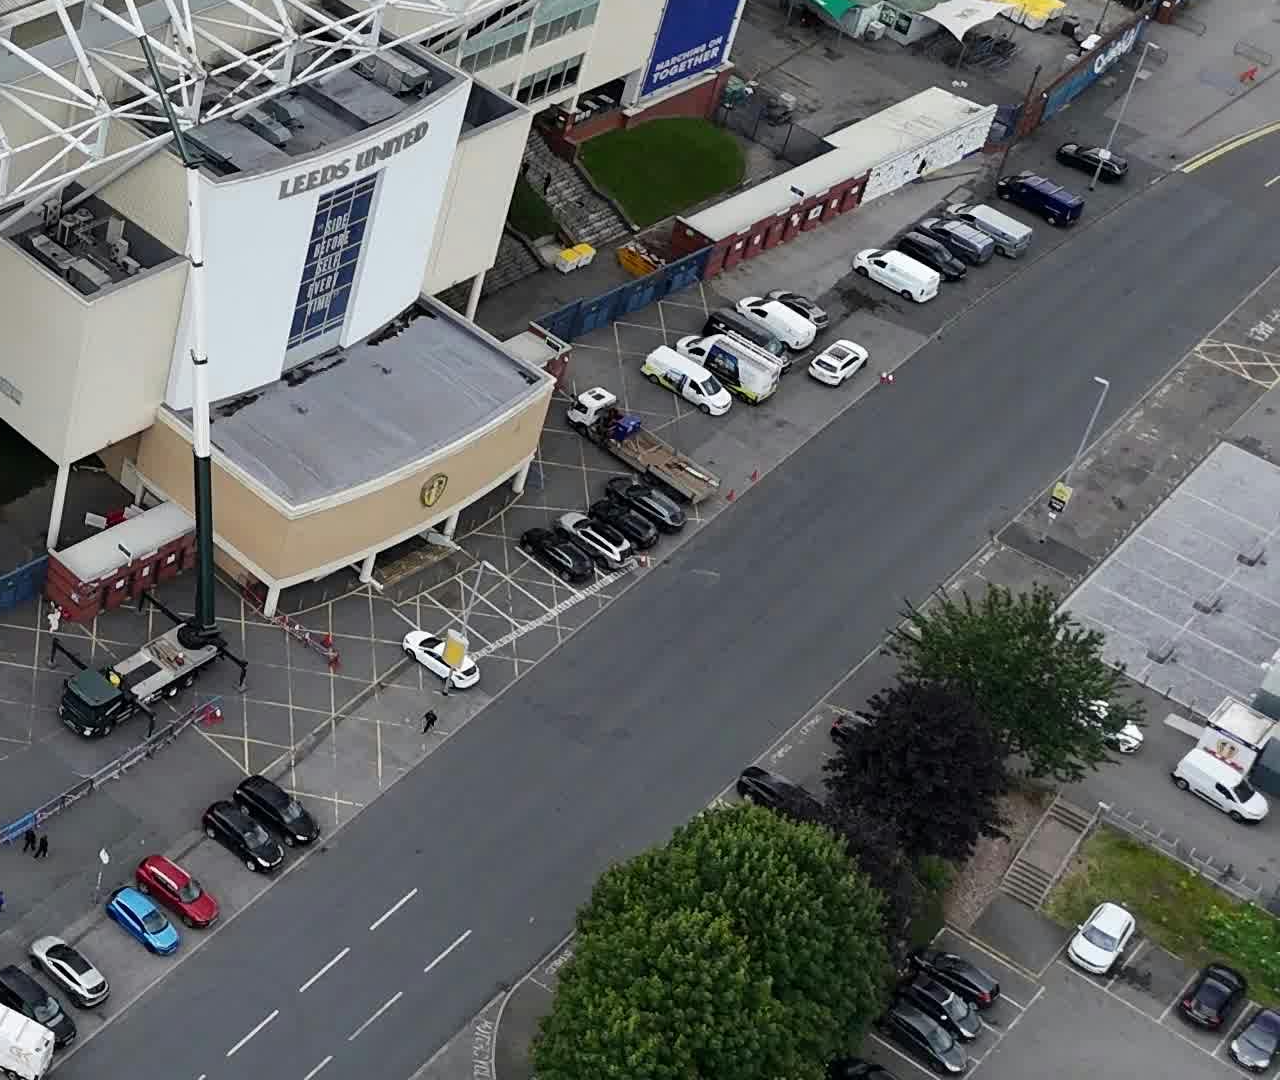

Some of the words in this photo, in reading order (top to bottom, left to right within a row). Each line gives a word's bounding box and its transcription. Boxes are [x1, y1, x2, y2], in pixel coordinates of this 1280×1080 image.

[652, 46, 720, 83] TOGETHER
[655, 43, 707, 71] MARCHING
[279, 158, 352, 200] LEEDS
[355, 121, 429, 172] UNITED
[326, 213, 350, 233] SIDE
[313, 230, 351, 258] BEFORE
